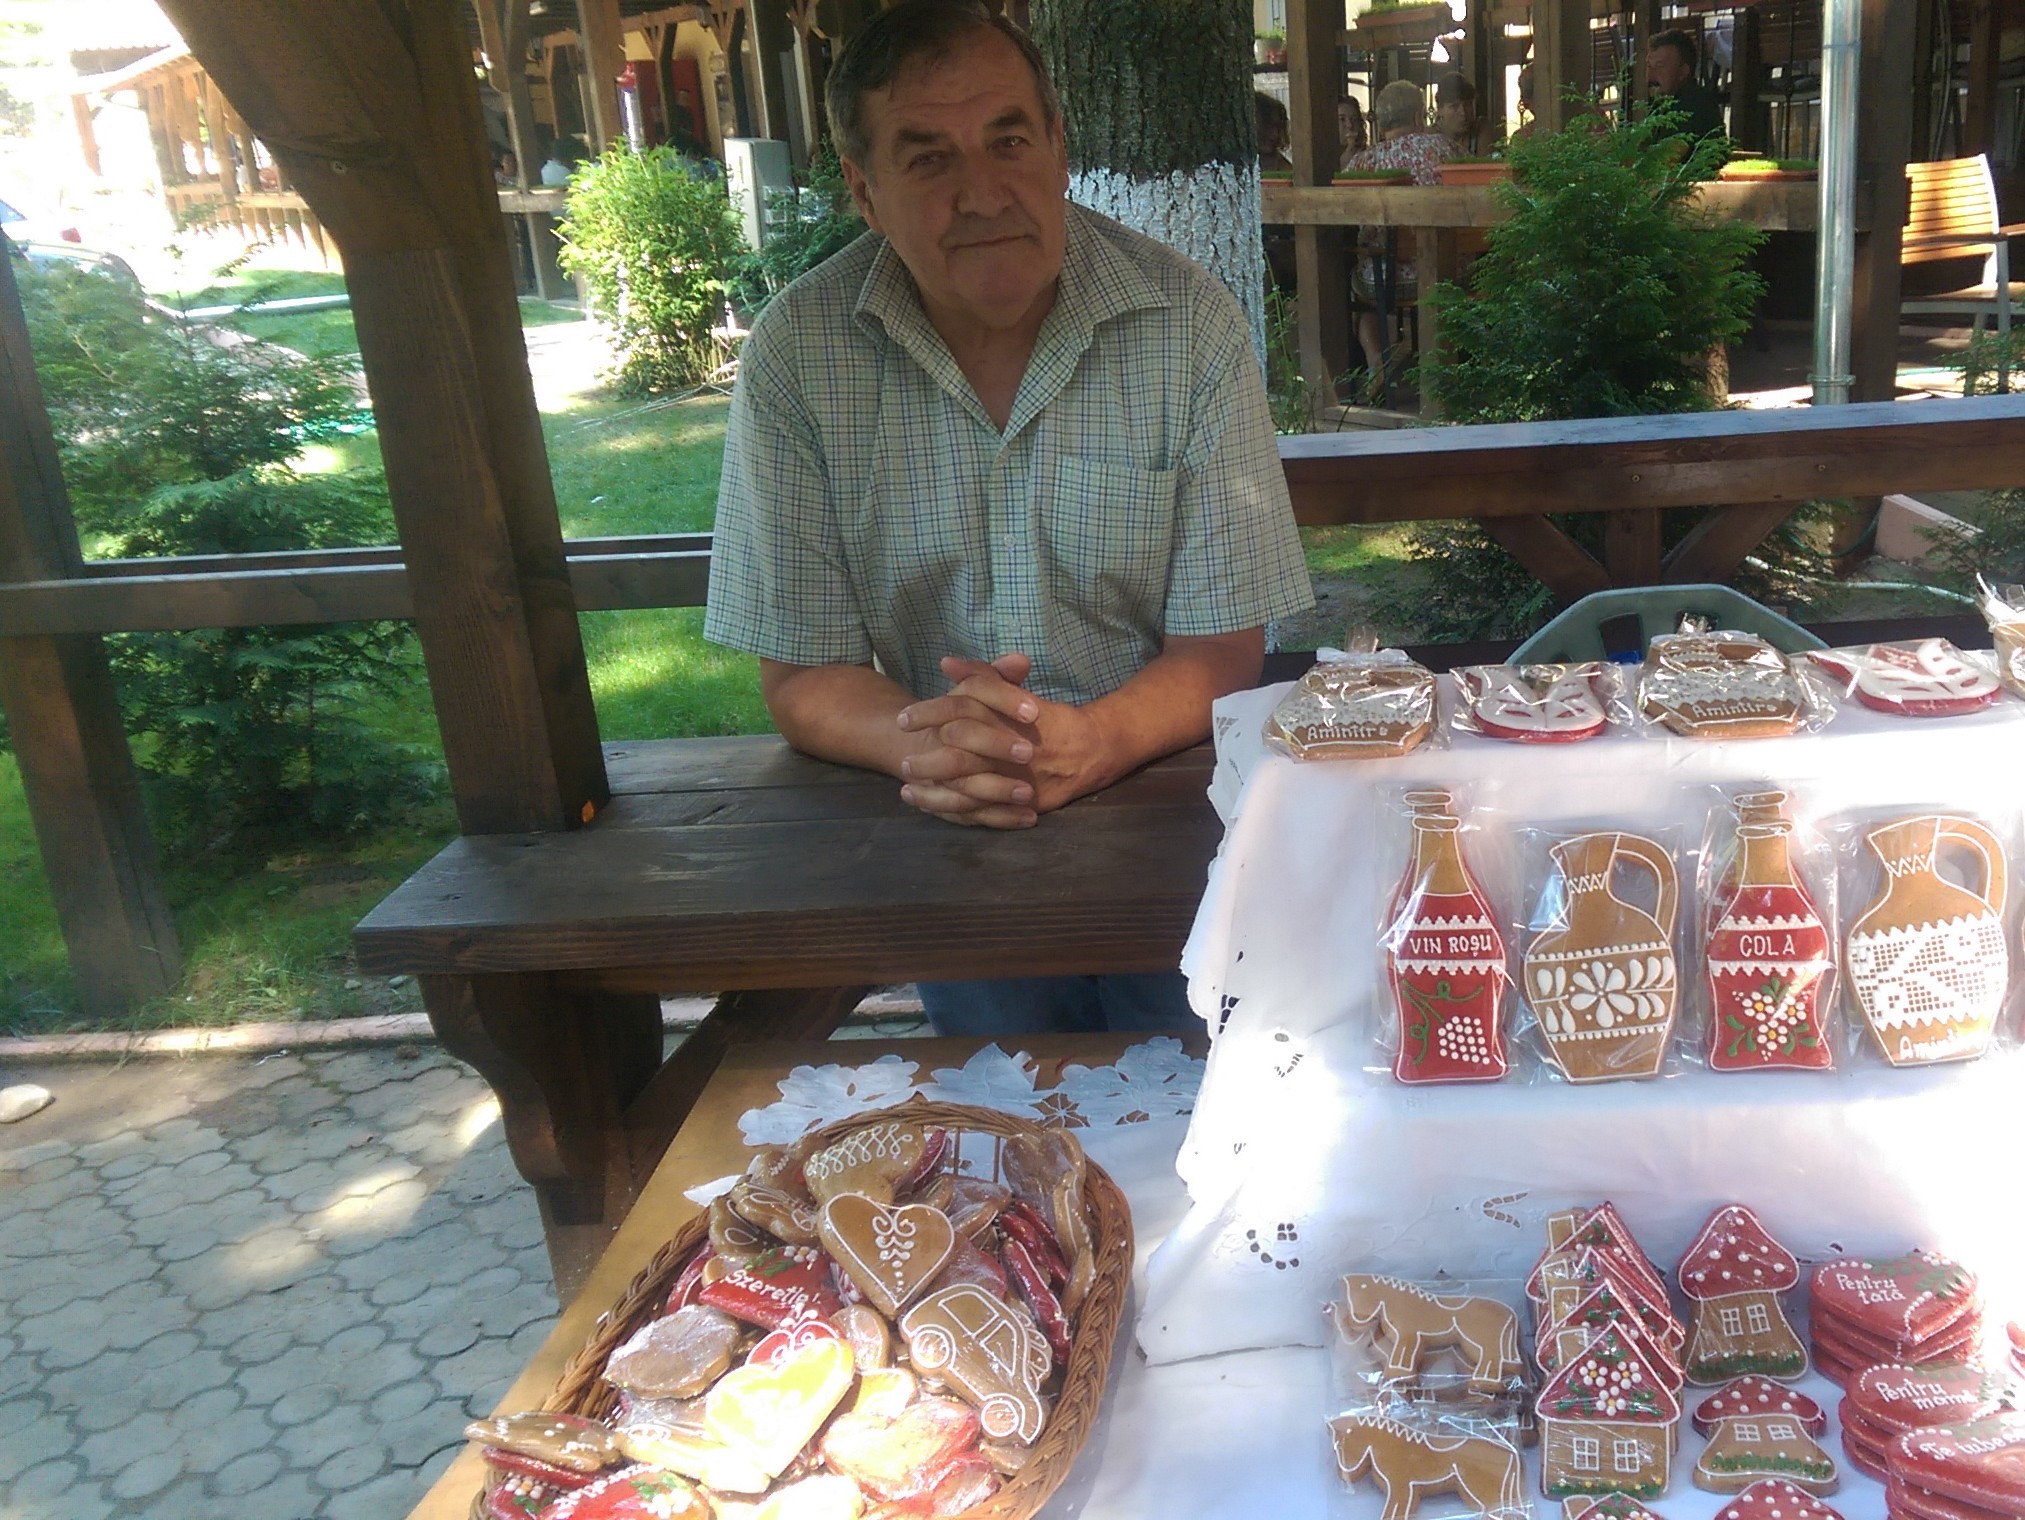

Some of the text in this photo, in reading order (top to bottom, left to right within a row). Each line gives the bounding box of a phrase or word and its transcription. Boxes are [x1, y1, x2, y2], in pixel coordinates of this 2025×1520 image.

[1410, 936, 1442, 954] VIN
[1740, 934, 1796, 957] COLA
[1836, 1273, 1897, 1291] Pentru
[1875, 1378, 1947, 1402] Pentru
